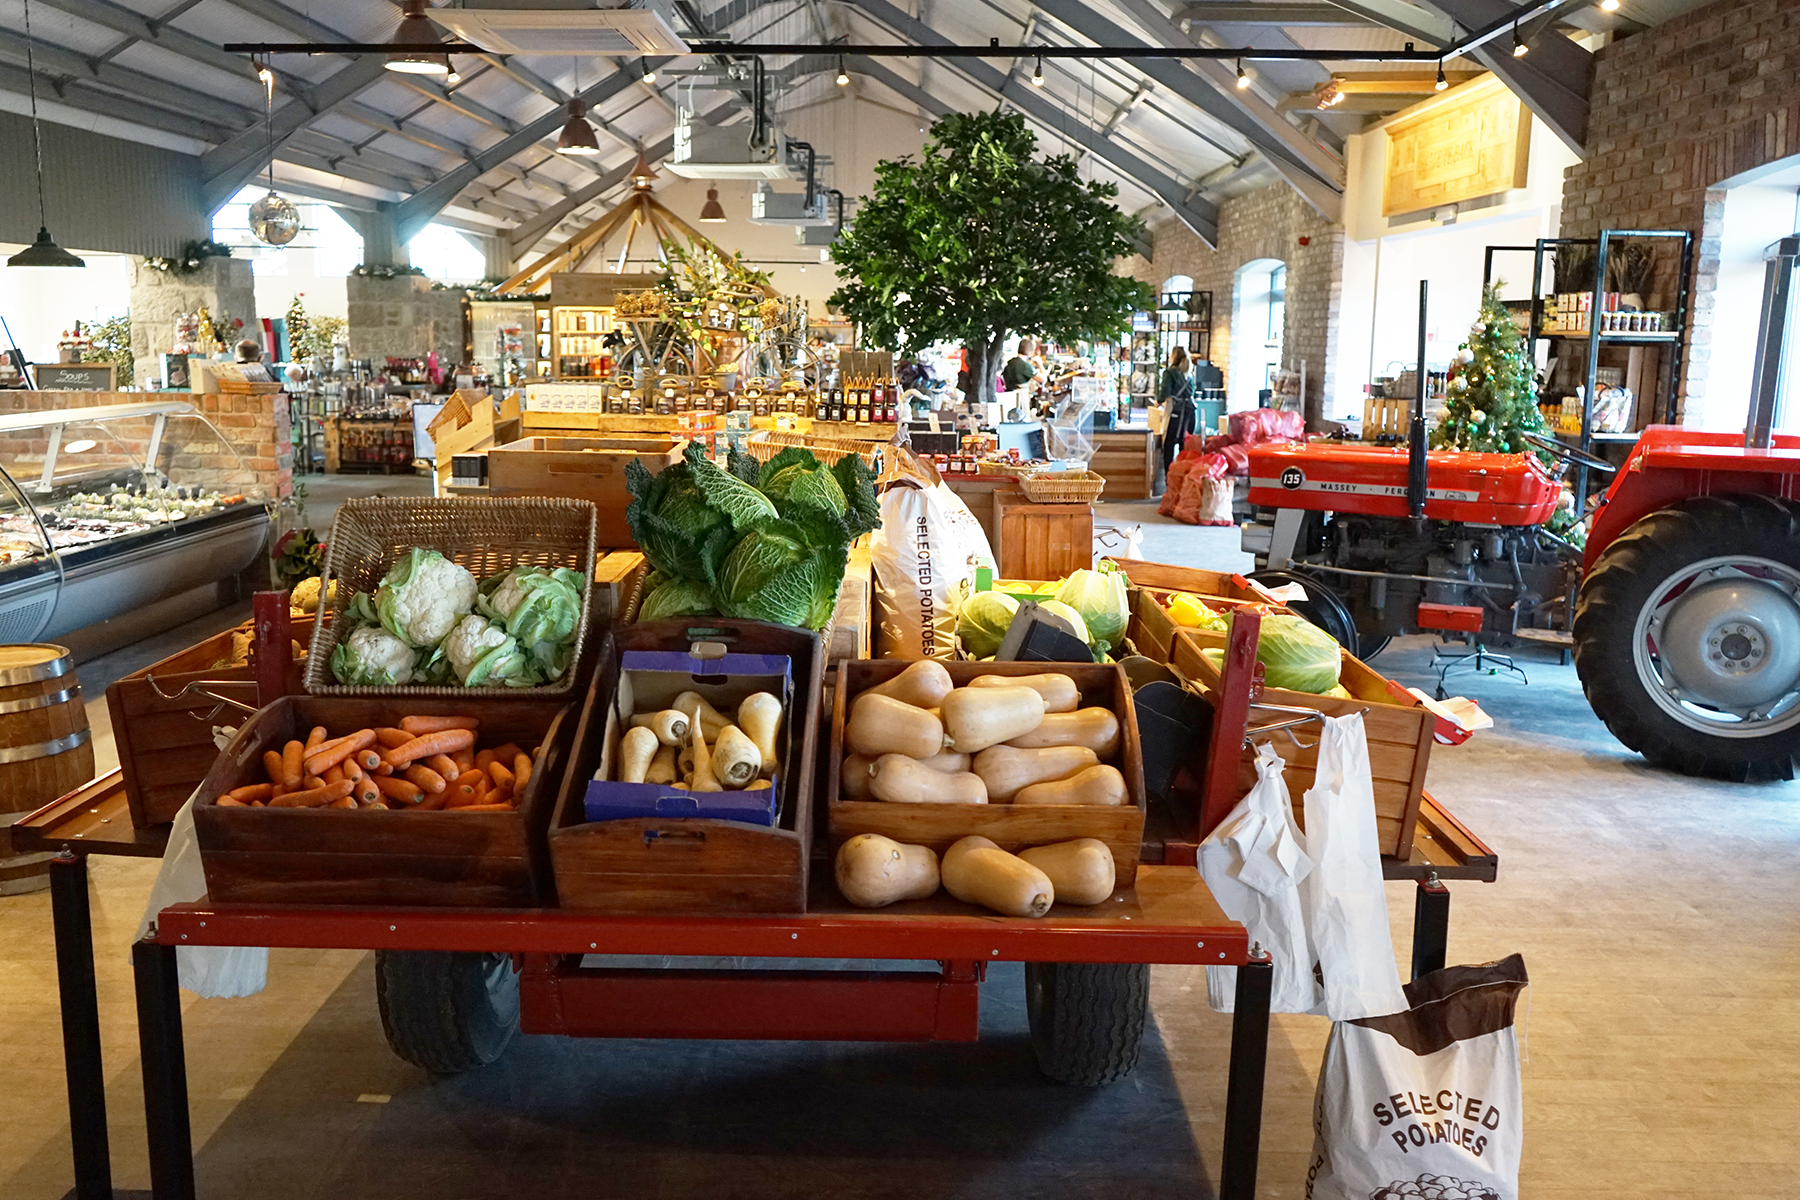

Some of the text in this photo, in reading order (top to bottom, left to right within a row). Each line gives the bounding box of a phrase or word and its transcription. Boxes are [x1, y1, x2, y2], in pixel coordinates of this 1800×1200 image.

[1283, 474, 1301, 485] 135
[1320, 483, 1436, 497] MASSEY FERGN
[916, 516, 935, 656] SELECTED POTATOES
[1373, 1089, 1501, 1131] SELECTED
[1391, 1119, 1488, 1157] POTATOES
